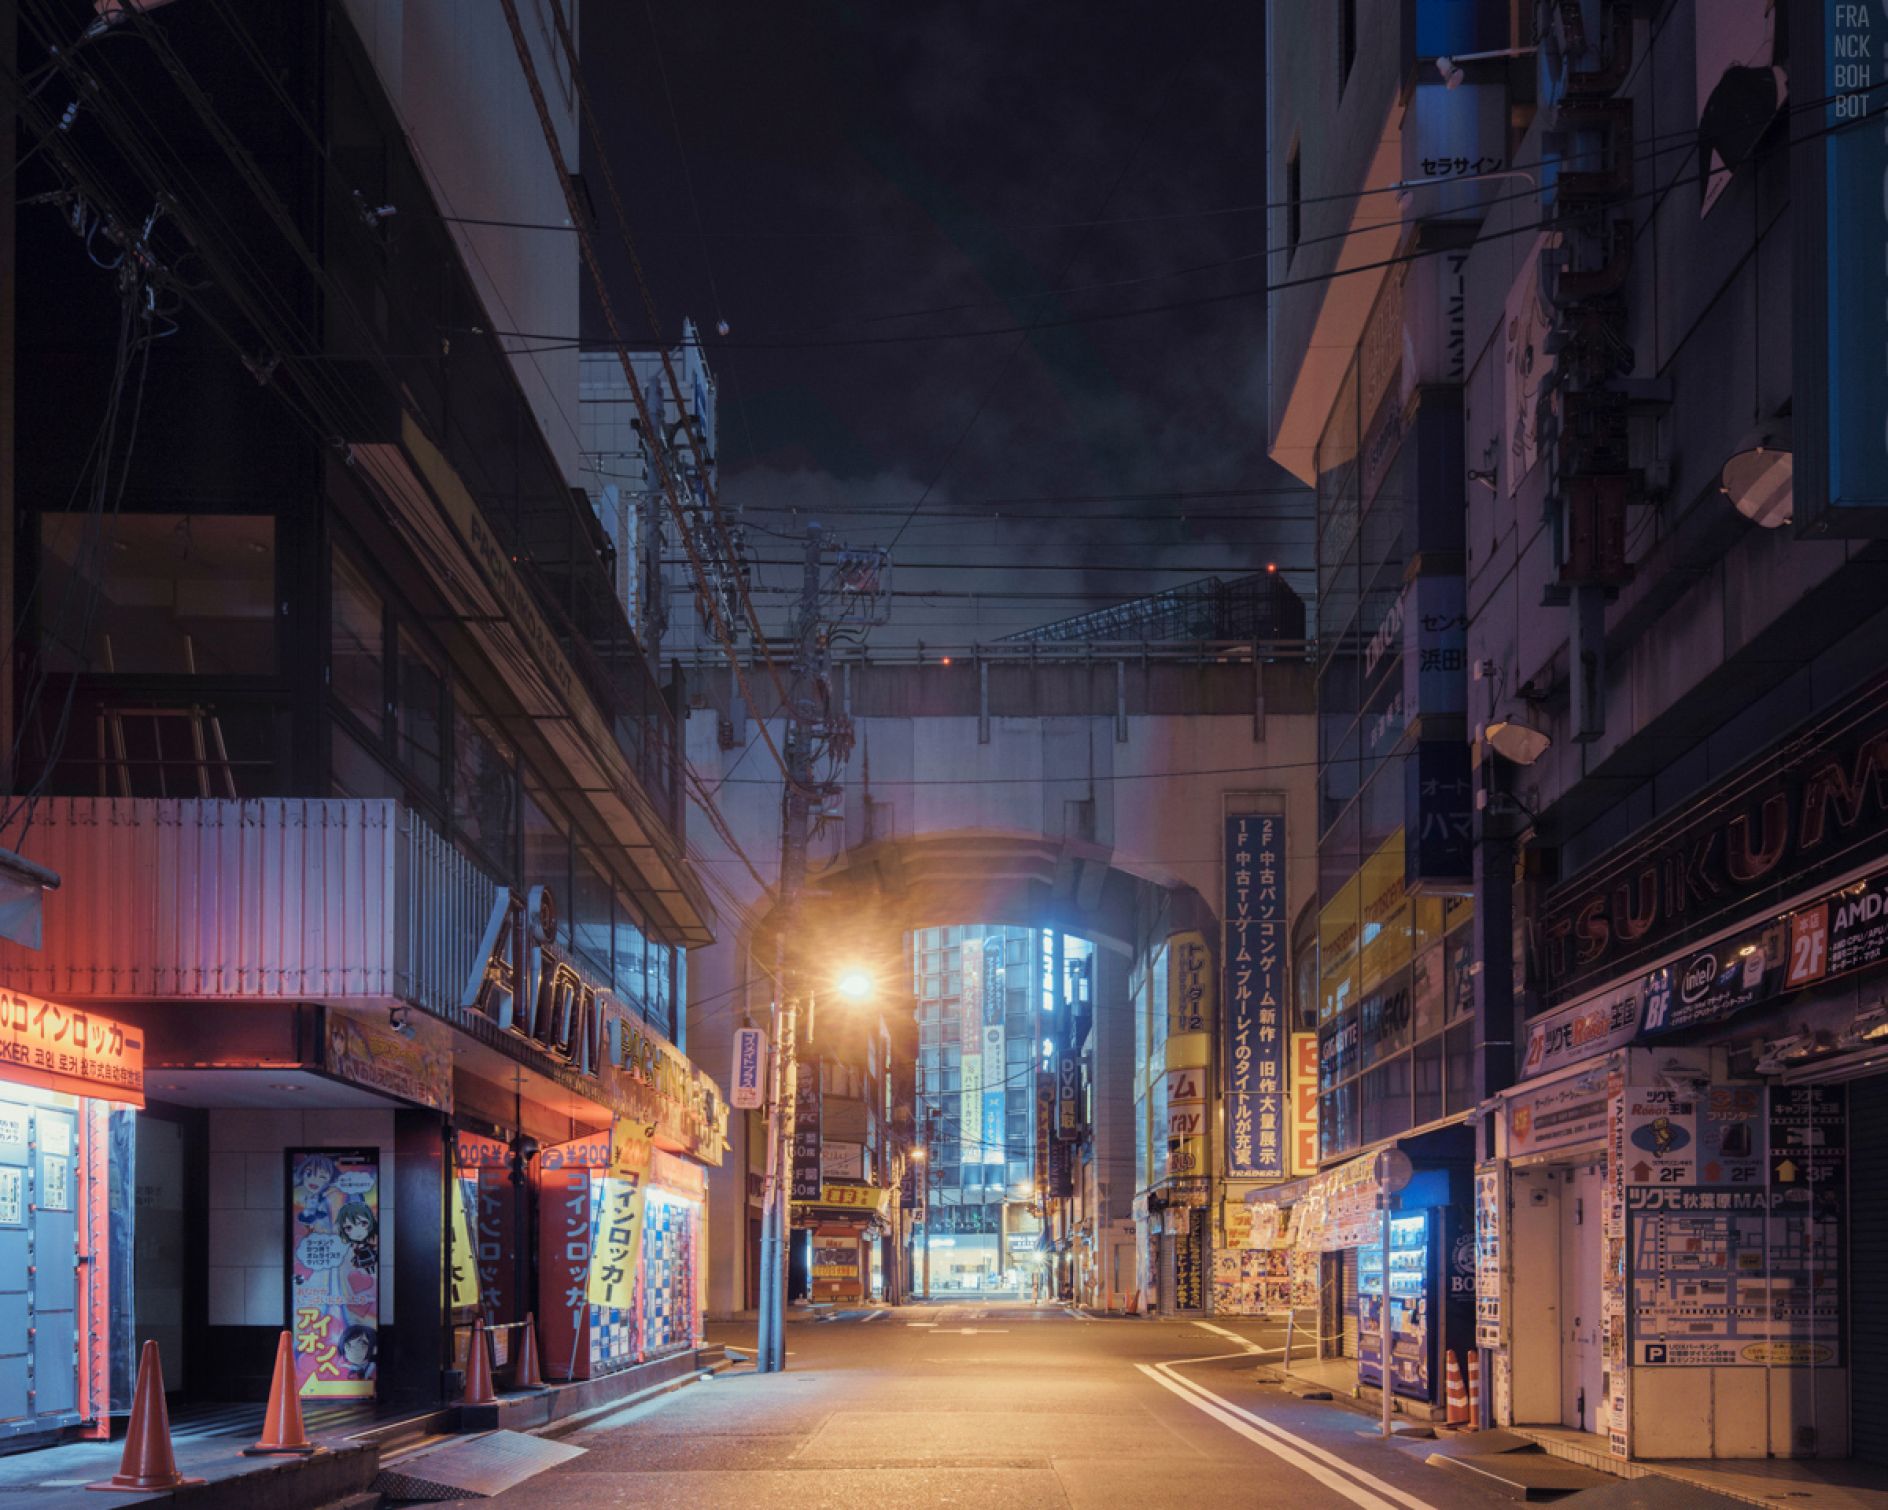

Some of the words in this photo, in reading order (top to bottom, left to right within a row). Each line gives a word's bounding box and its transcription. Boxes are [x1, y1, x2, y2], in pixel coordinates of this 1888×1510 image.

[1421, 158, 1502, 176] セラサイン
[1420, 650, 1468, 672] 浜田
[1237, 819, 1249, 847] 1F
[1261, 819, 1274, 847] 2F
[1833, 892, 1882, 933] AMD
[1792, 928, 1825, 980] 2F
[1685, 961, 1711, 992] intel
[1061, 1058, 1074, 1099] DVD
[567, 1143, 610, 1166] ¥200
[1660, 1168, 1685, 1182] 2F
[1731, 1168, 1756, 1182] 2F
[601, 1168, 640, 1303] コインロッカー
[565, 1173, 589, 1331] コインロッカー
